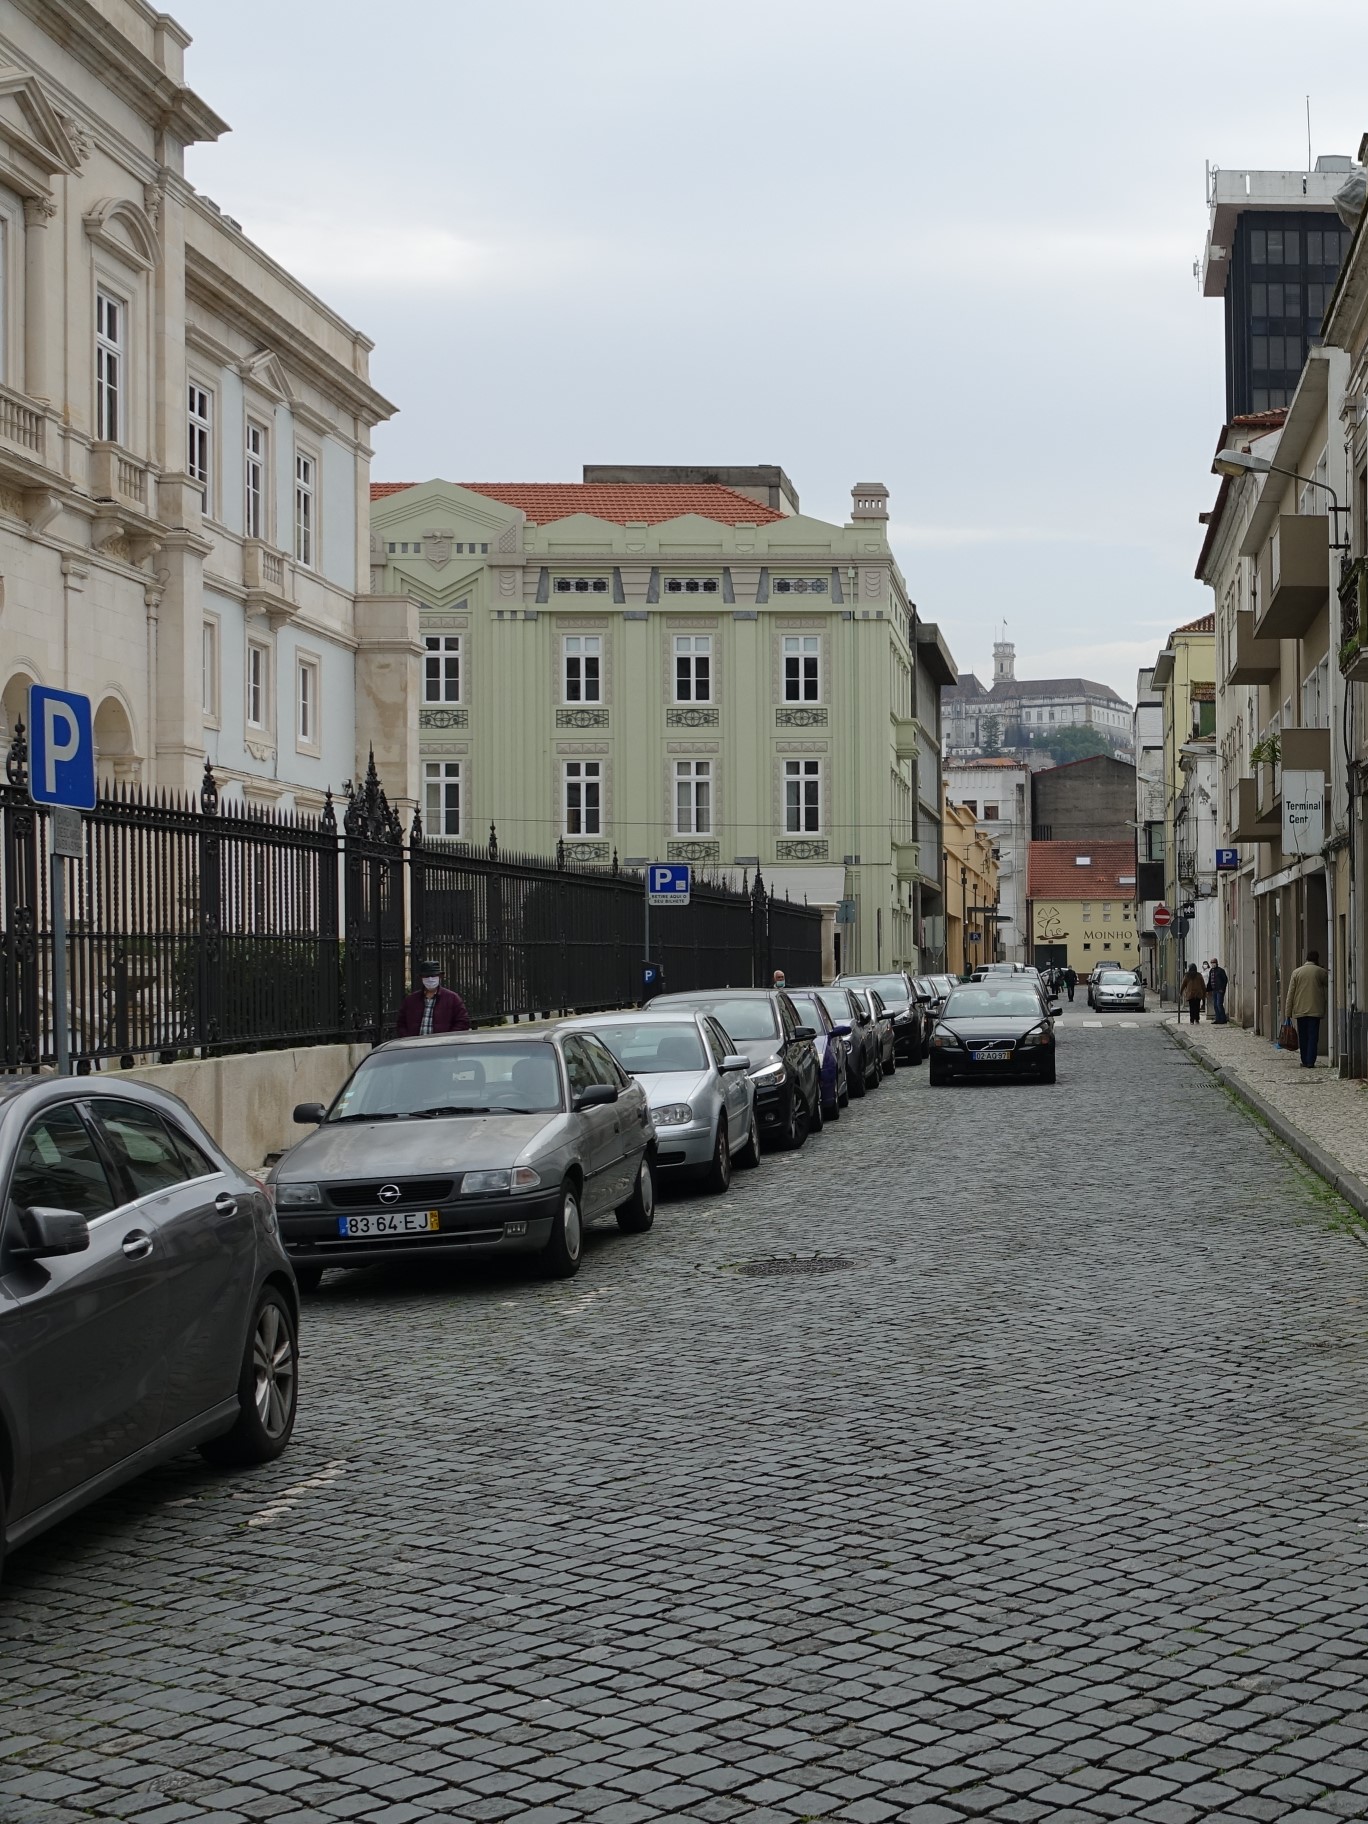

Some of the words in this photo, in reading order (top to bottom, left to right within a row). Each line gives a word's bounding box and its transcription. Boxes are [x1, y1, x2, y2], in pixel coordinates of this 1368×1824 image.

[43, 697, 80, 793] P
[1286, 801, 1321, 811] Terminal
[1222, 851, 1233, 863] P
[655, 868, 672, 891] P
[1083, 930, 1134, 940] MOINHO
[645, 970, 653, 981] P
